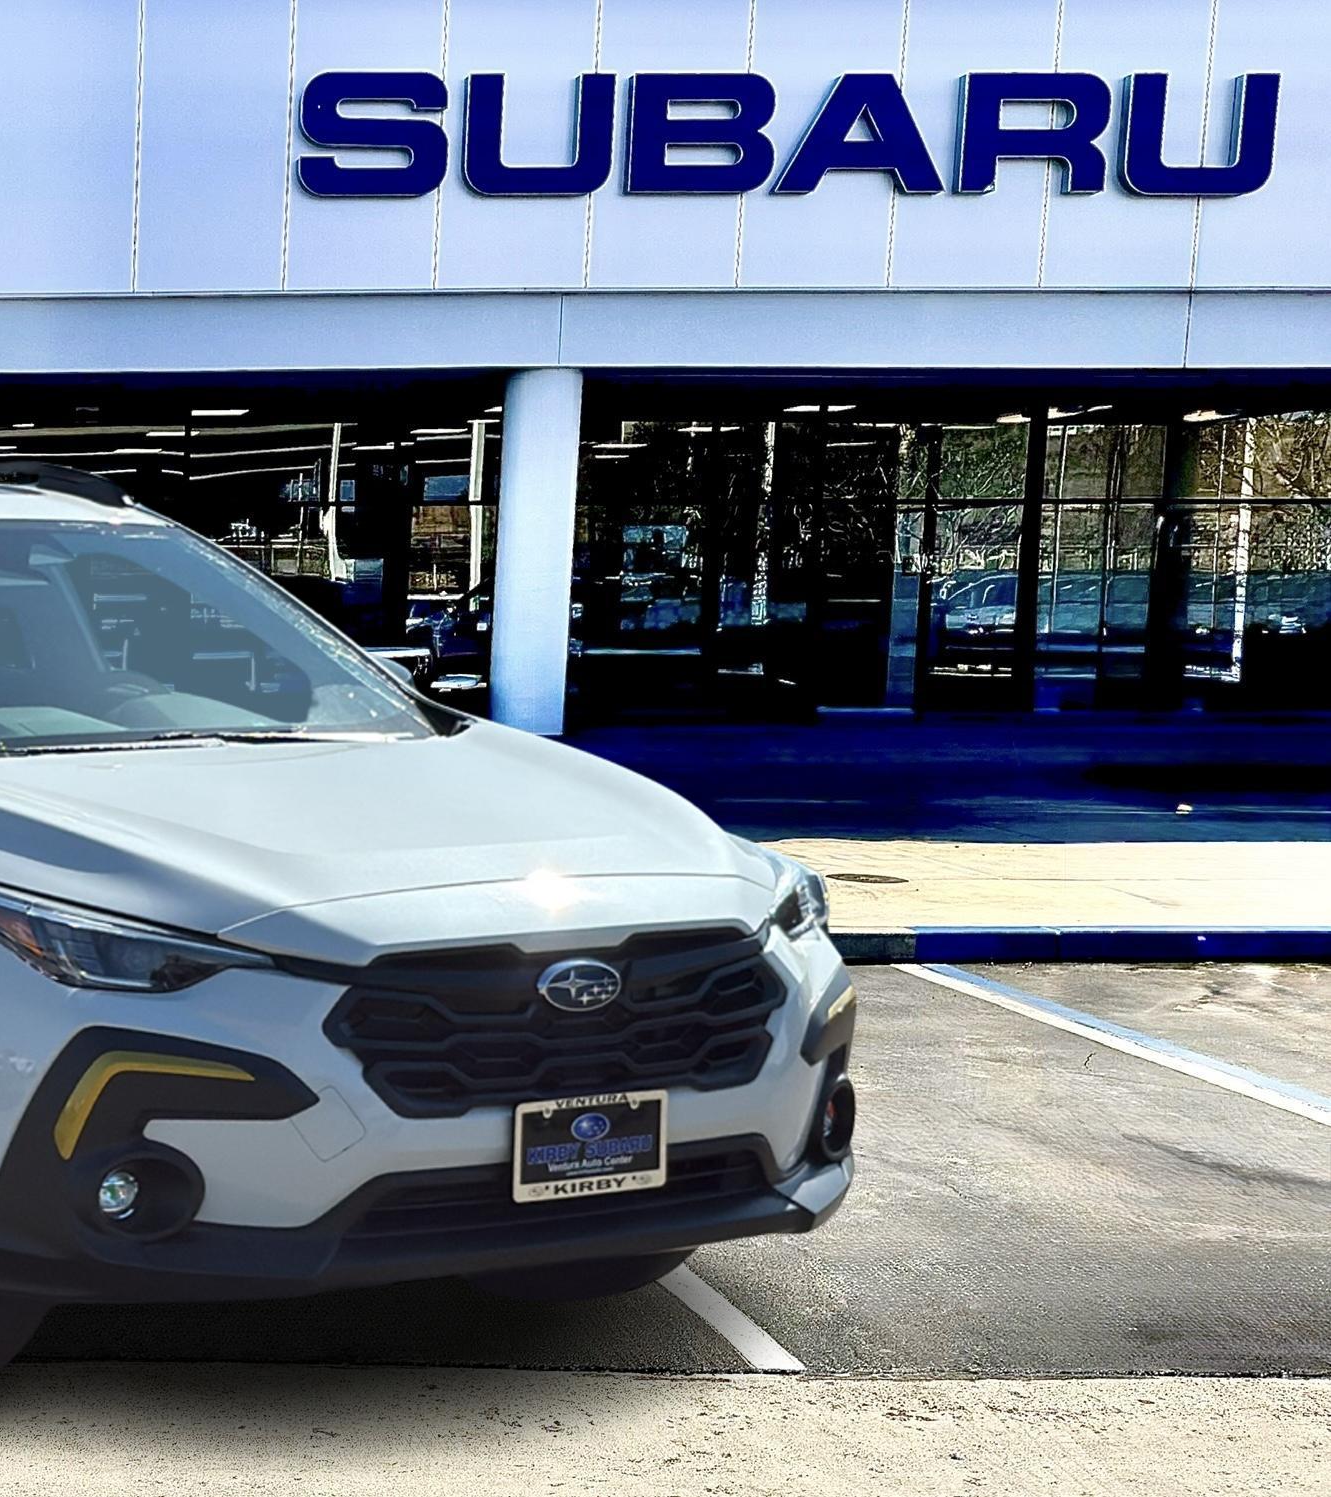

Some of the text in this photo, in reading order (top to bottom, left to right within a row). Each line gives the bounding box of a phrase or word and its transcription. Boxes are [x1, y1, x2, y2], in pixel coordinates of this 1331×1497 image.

[296, 70, 1282, 198] SUBARU
[555, 1092, 628, 1109] VENTURA
[526, 1134, 653, 1165] KIRBY SUBARU
[581, 1158, 602, 1169] Auto
[604, 1154, 634, 1166] Center
[553, 1176, 627, 1196] KIRBY
